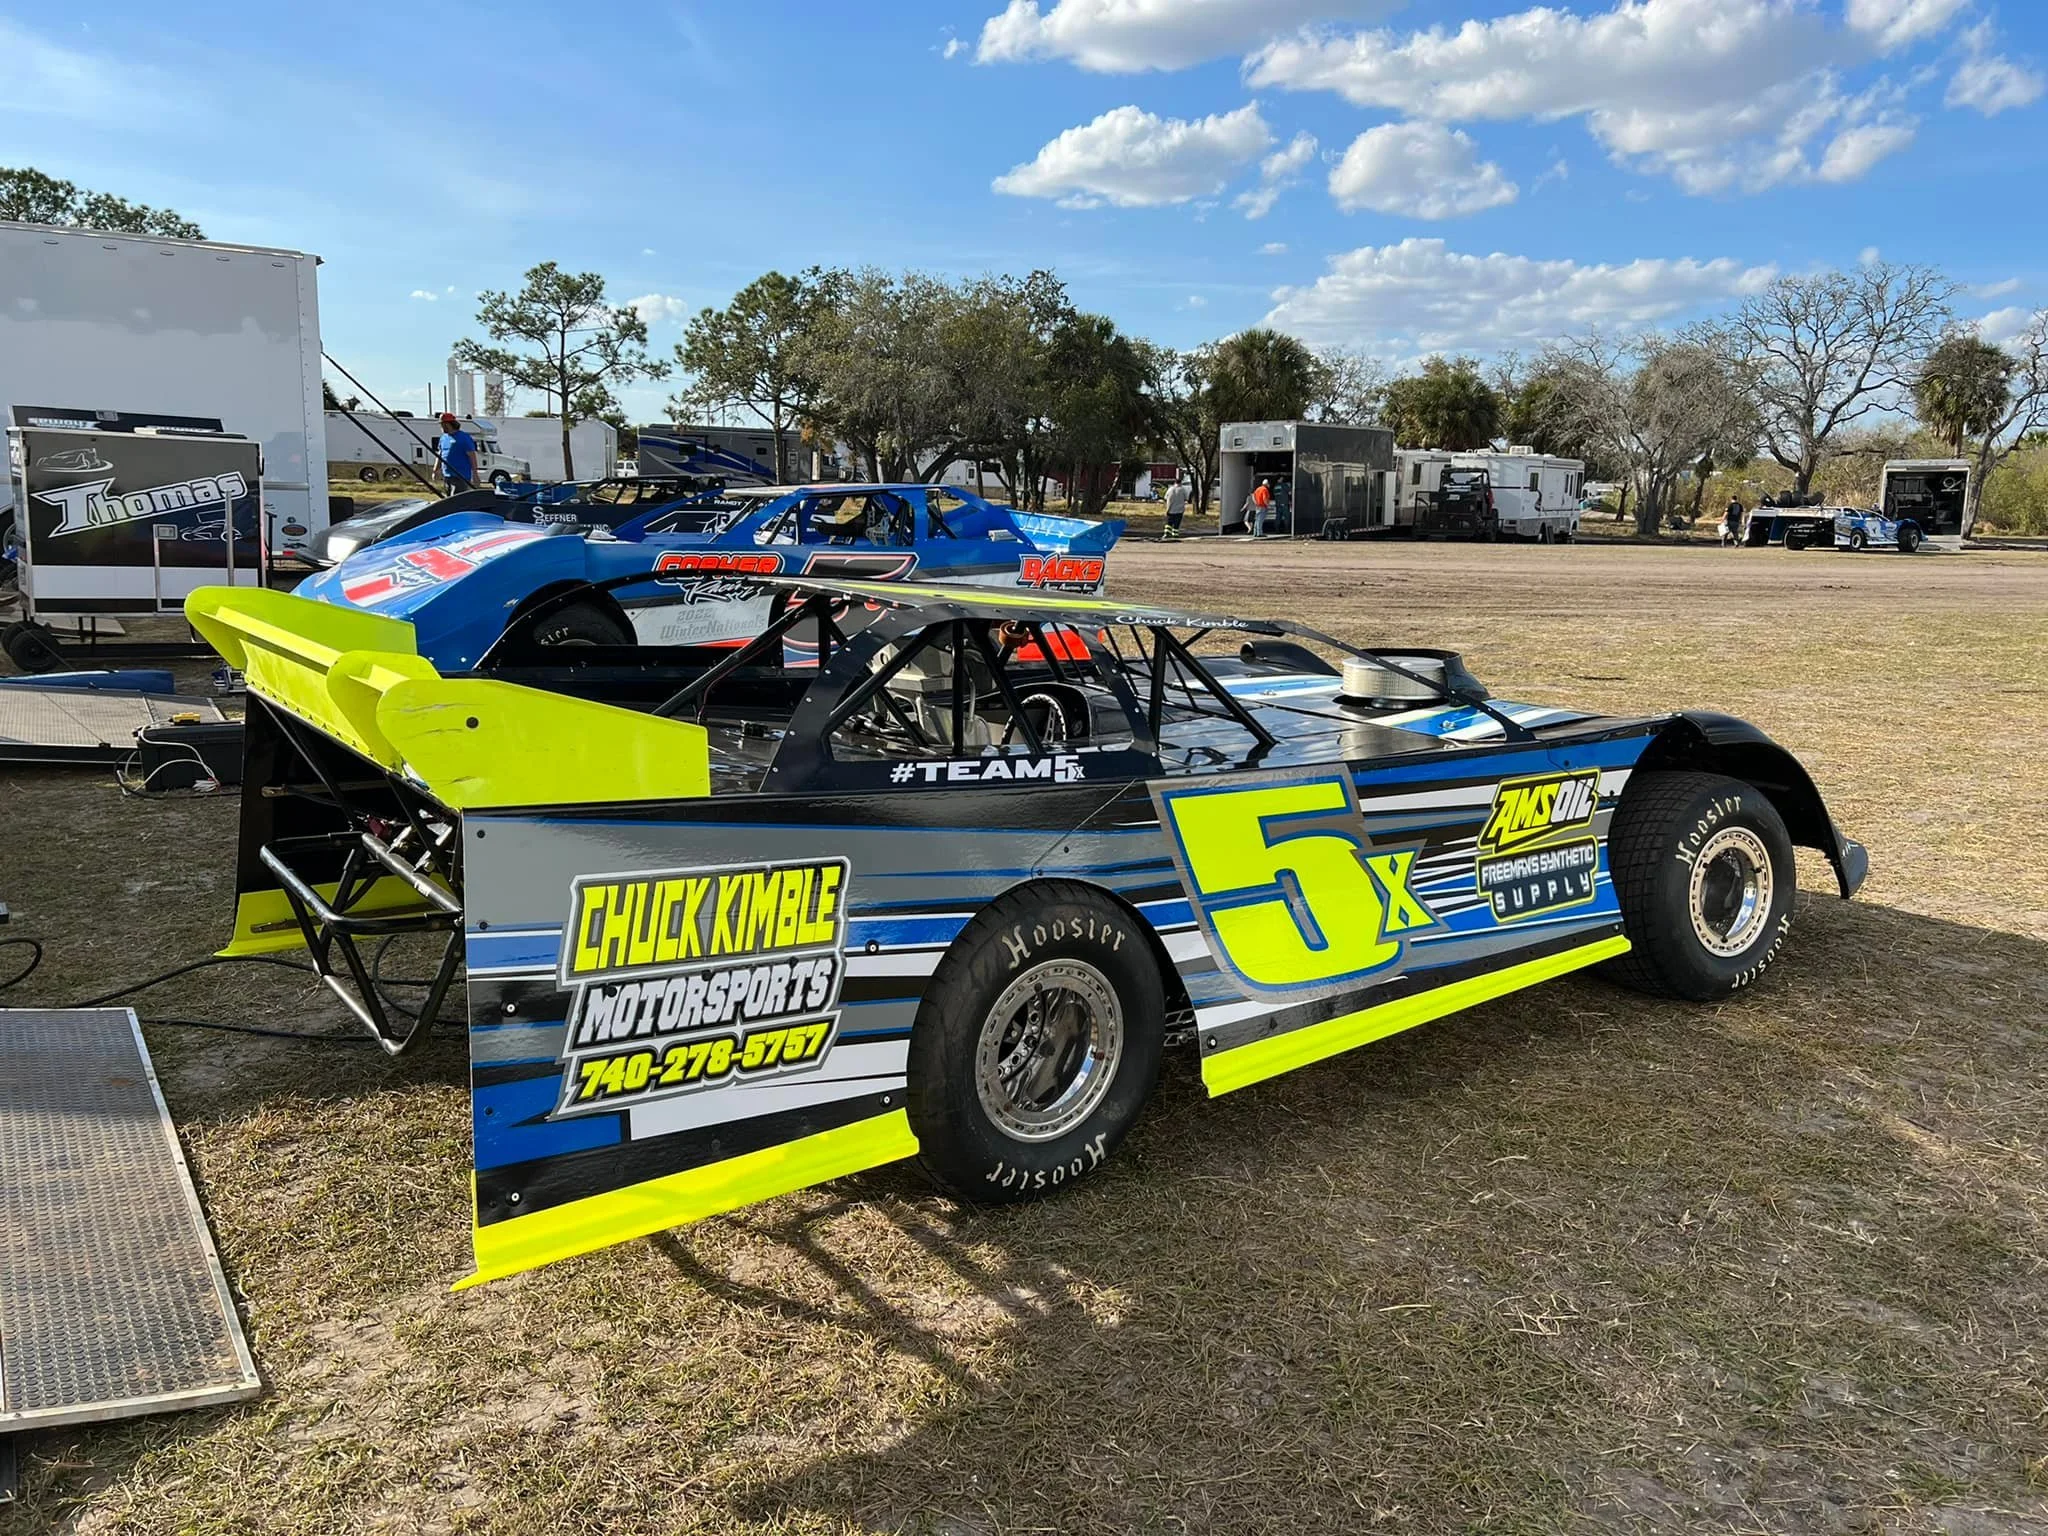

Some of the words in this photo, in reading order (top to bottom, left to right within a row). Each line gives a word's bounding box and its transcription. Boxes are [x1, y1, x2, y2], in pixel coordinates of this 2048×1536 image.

[31, 471, 248, 538] Thomas
[532, 506, 577, 522] SEFFNER
[1022, 556, 1105, 586] BACKS
[677, 607, 713, 622] 2022
[1115, 614, 1179, 626] Chuck
[1185, 616, 1249, 629] Kimble
[1487, 777, 1596, 847] AMSOIL
[1674, 795, 1742, 871] Hoosier
[1540, 845, 1594, 872] SYNTHETIC
[573, 875, 712, 972] CHUCK
[710, 865, 842, 956] KIMBLE
[1494, 872, 1591, 913] SUPPLY
[1001, 910, 1127, 970] Hoosier
[1731, 912, 1791, 989] Hoosier
[577, 958, 833, 1045] MOTORSPORTS
[577, 1022, 830, 1101] 740-278-5757
[985, 1130, 1107, 1191] Hoosier
